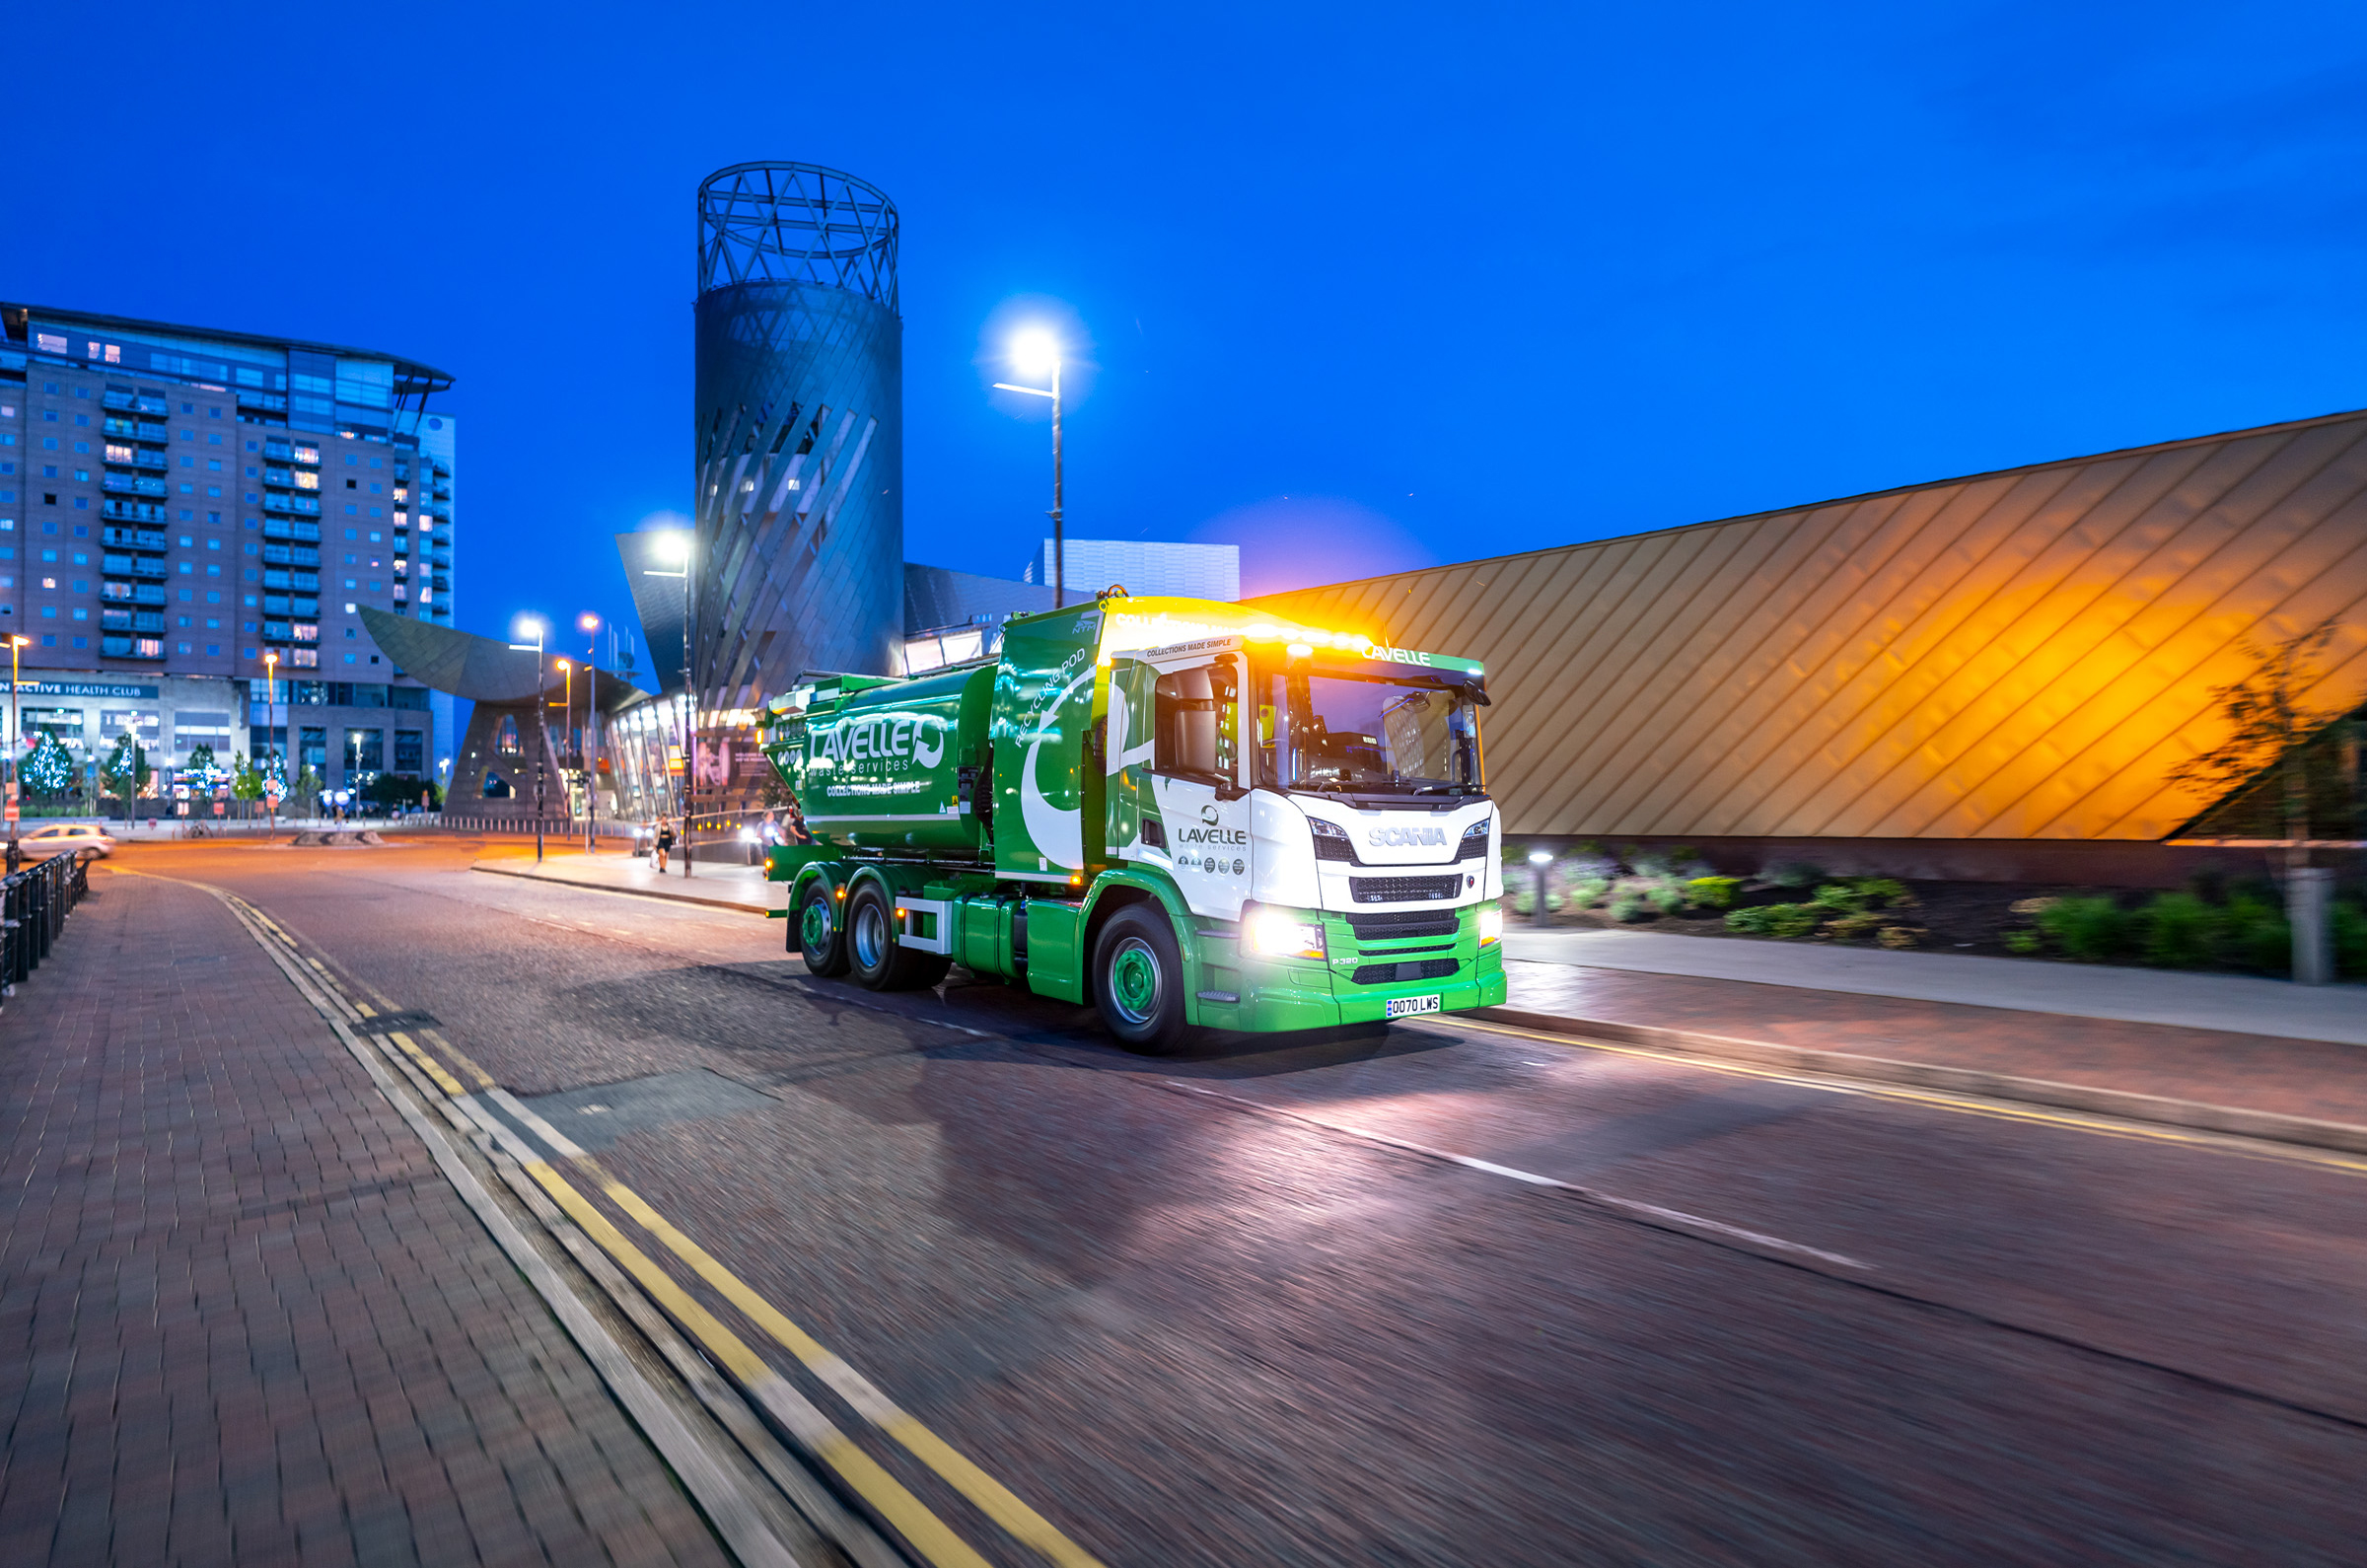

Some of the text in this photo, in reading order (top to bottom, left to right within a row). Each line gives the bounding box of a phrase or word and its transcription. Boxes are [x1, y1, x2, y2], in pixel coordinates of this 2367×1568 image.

[1072, 622, 1096, 634] NTM
[1147, 638, 1231, 658] COLLECTIONS MADE SIMPLE
[1362, 645, 1431, 667] LAVELLE
[15, 682, 61, 694] ACTIVE
[65, 684, 108, 696] HEALTH
[111, 686, 141, 697] CLUB
[1015, 647, 1085, 748] RECYCLING POD
[810, 719, 911, 762] LAVELLE
[810, 758, 908, 777] waste services
[826, 780, 920, 797] COLLECTIONS MADE SIMPLE
[1178, 827, 1247, 845] LAVELLE
[1368, 826, 1448, 847] SCANIA
[1420, 996, 1439, 1011] LWS
